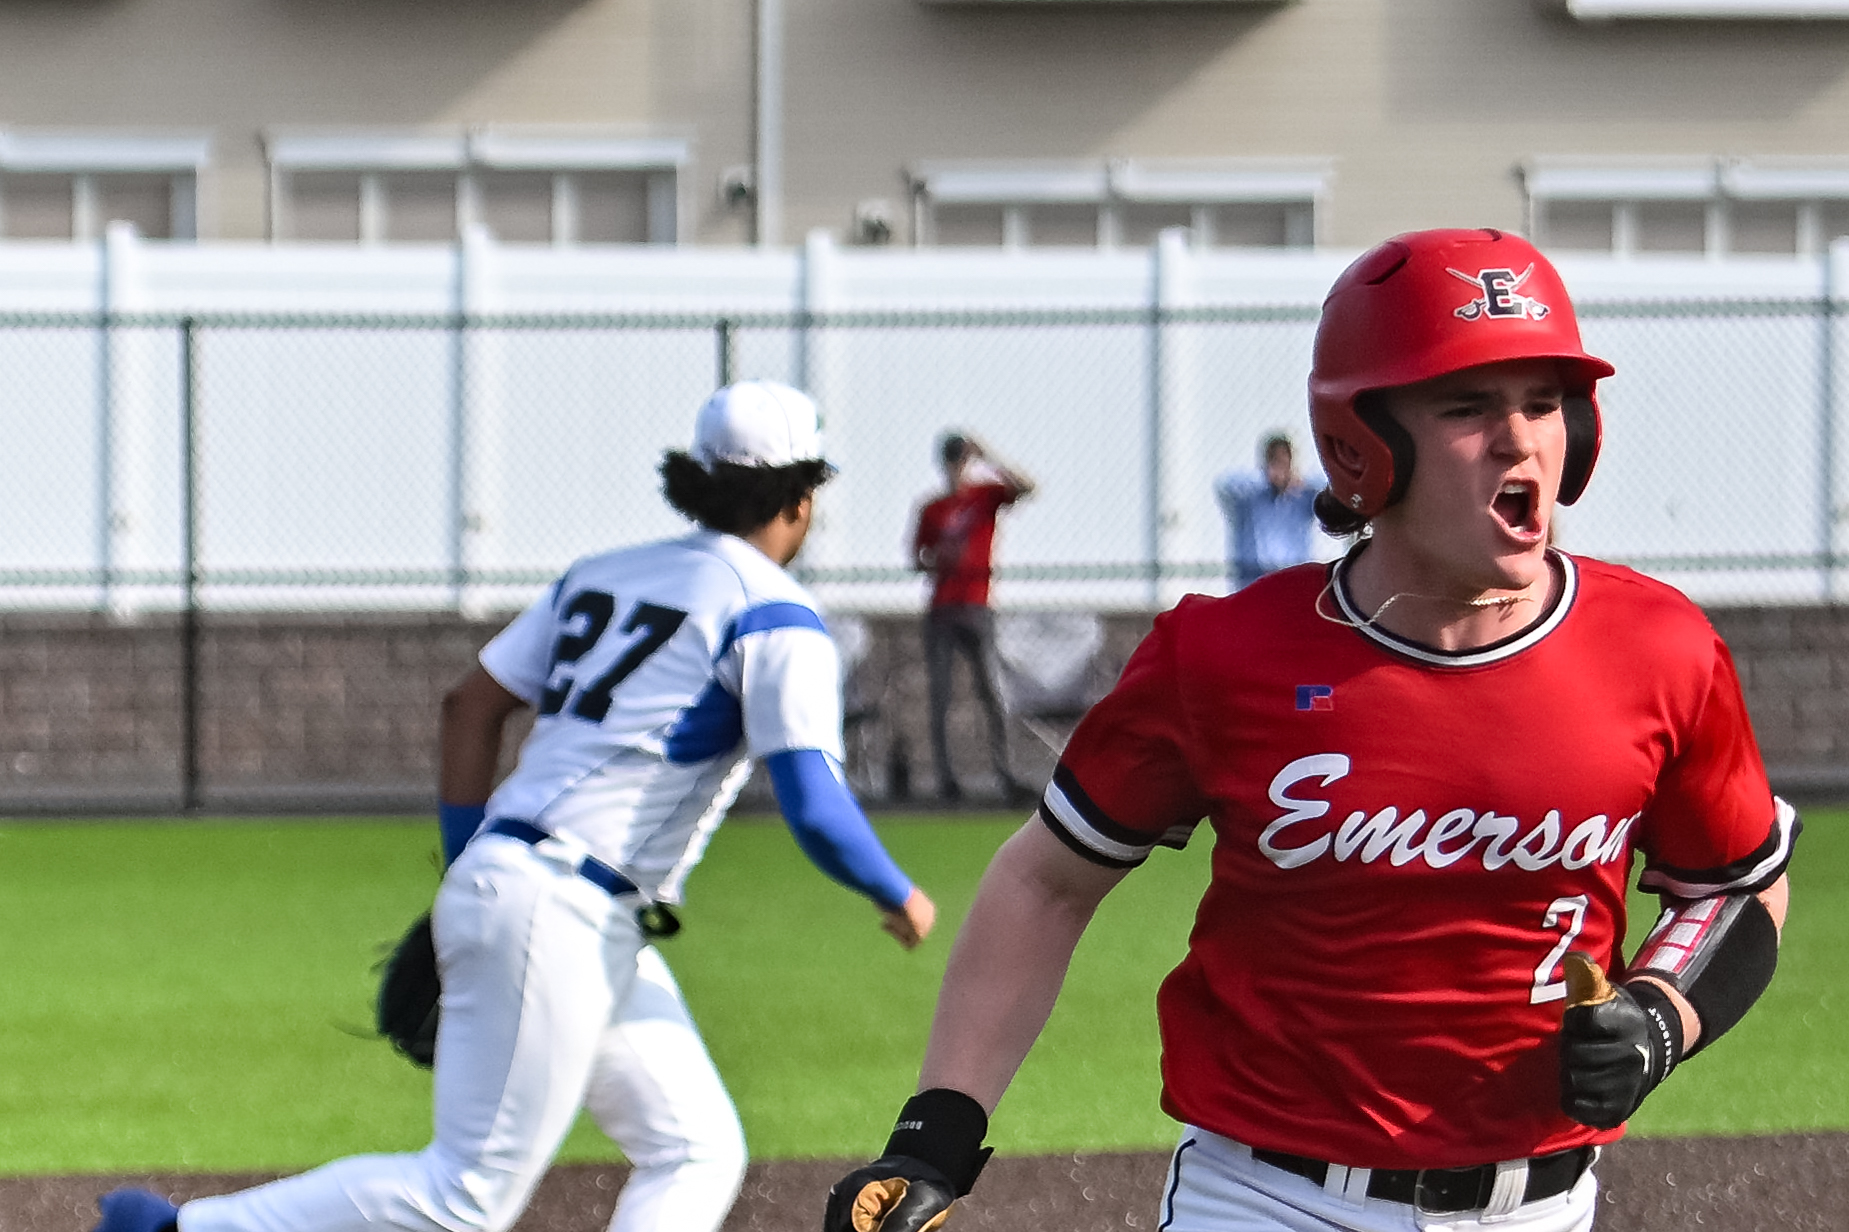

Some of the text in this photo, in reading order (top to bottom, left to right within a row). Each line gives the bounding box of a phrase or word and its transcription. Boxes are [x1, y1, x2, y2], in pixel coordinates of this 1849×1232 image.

[1478, 269, 1526, 319] E
[540, 588, 689, 723] 27
[1257, 753, 1642, 871] Emerson
[1530, 894, 1589, 1004] 2
